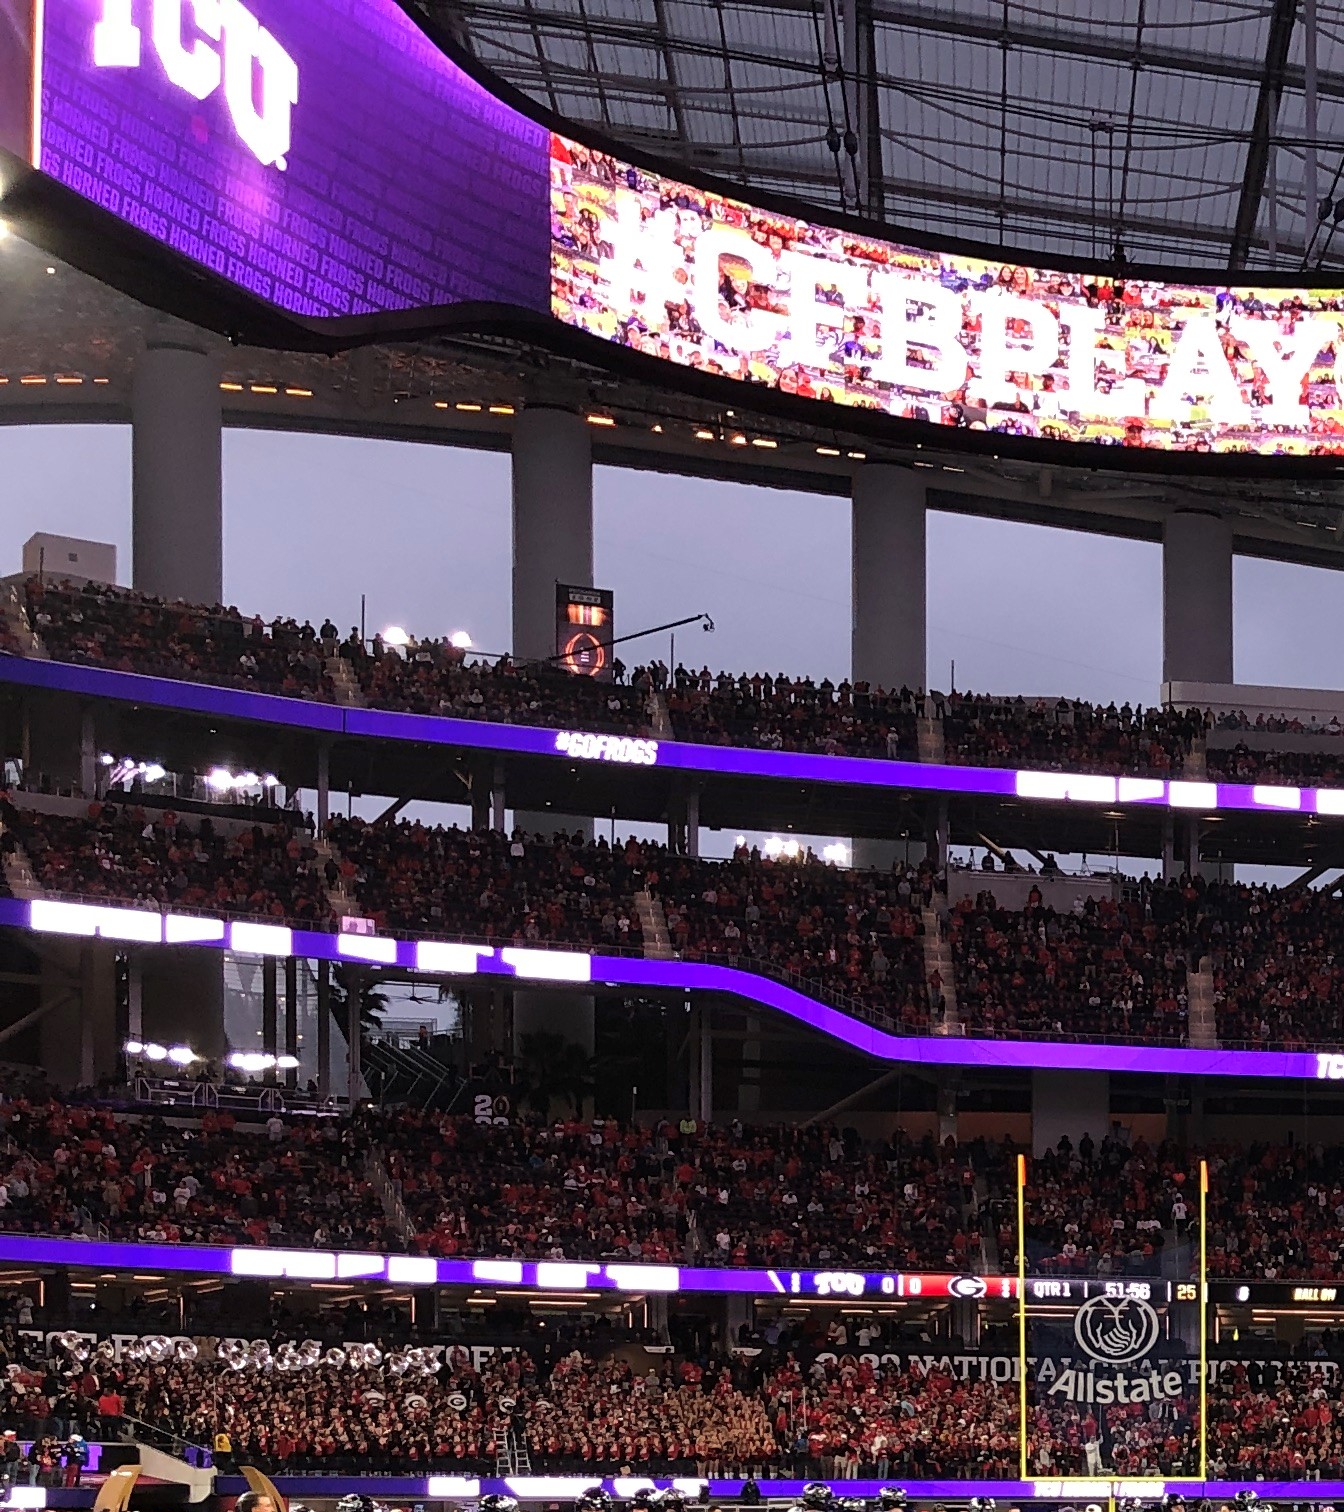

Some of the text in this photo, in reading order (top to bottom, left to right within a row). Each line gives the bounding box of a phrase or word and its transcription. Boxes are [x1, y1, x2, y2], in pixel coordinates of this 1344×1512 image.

[556, 731, 658, 765] #GOFROGS
[814, 1272, 865, 1296] TCU
[882, 1277, 895, 1293] 0
[909, 1278, 922, 1293] 0
[1034, 1283, 1061, 1299] QTR
[1177, 1285, 1197, 1300] 25
[1048, 1367, 1183, 1404] Allstate
